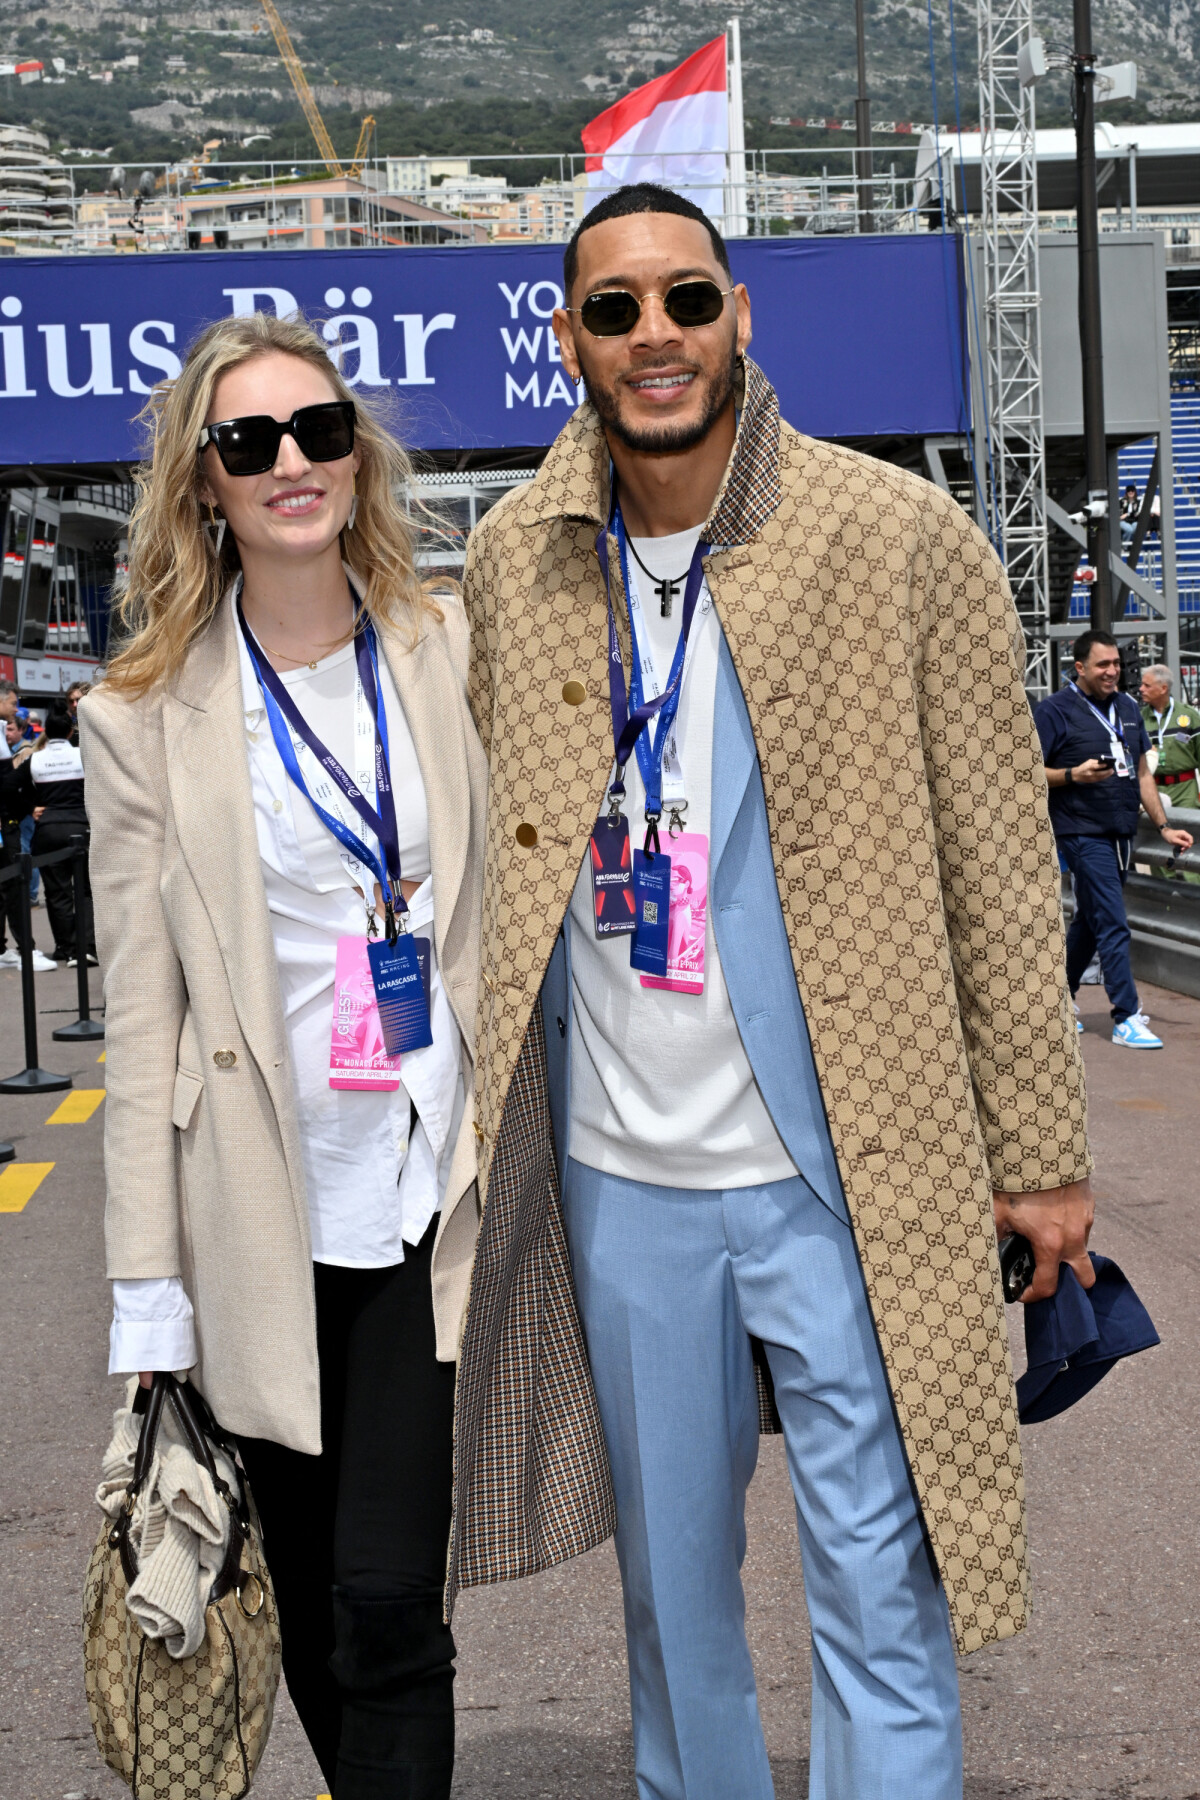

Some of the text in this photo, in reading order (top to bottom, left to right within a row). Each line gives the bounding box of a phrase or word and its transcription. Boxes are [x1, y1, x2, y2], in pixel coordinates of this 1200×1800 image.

[389, 962, 410, 972] RACING
[378, 973, 418, 991] LA RASCASSE
[337, 989, 352, 1036] GUEST
[344, 1058, 373, 1068] MONACO
[335, 1070, 365, 1078] SATURDAY
[366, 1071, 383, 1079] APRIL
